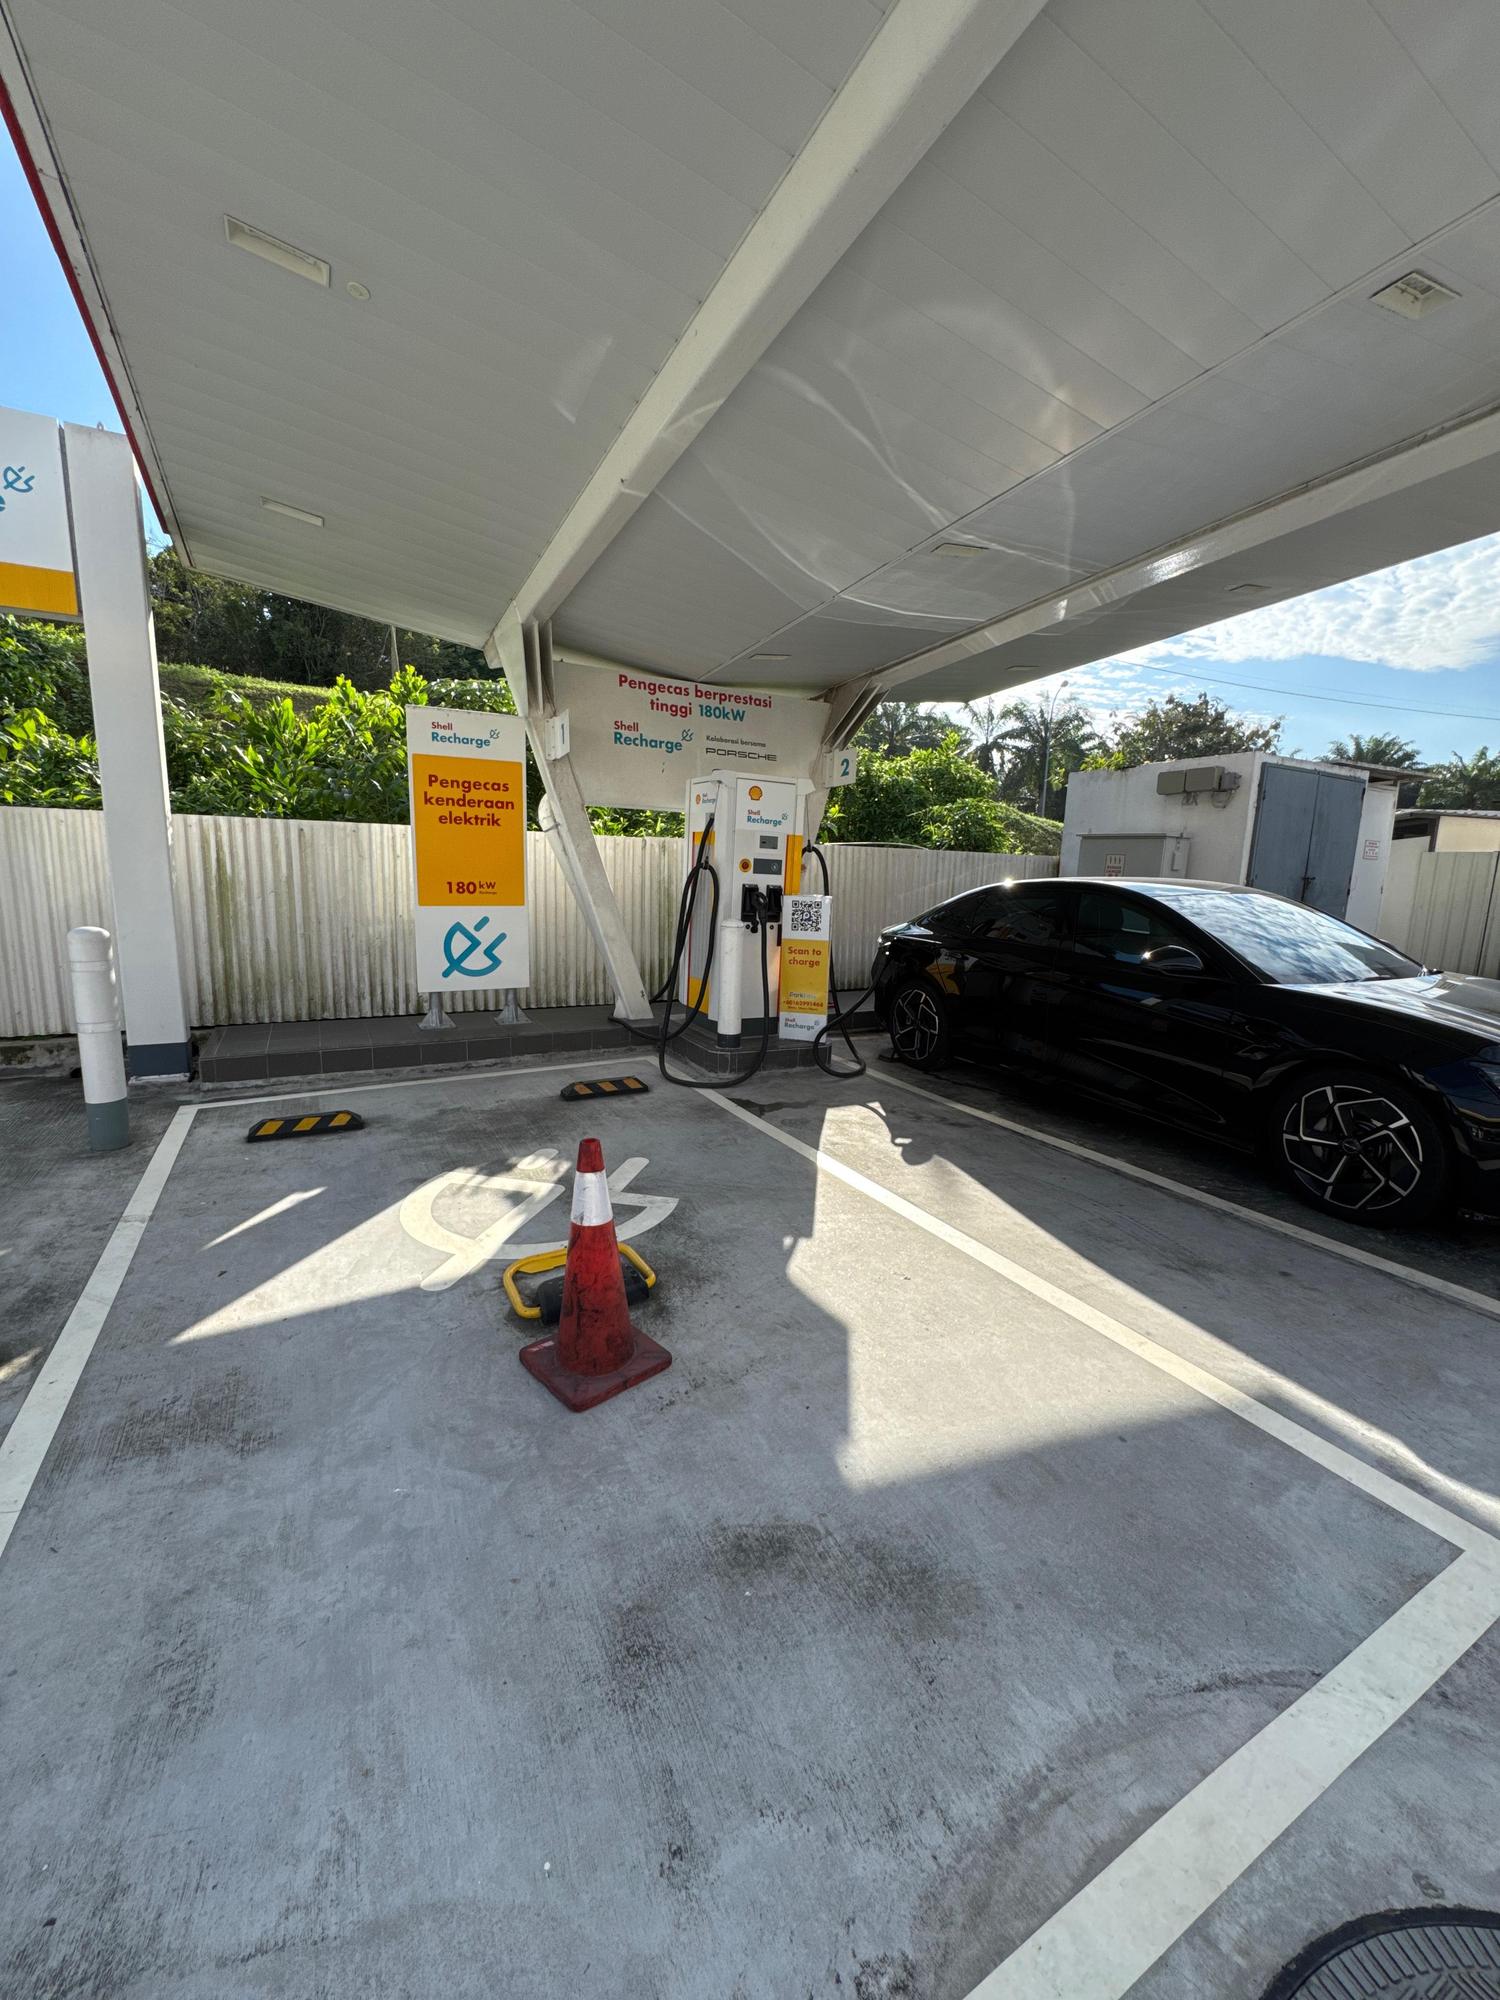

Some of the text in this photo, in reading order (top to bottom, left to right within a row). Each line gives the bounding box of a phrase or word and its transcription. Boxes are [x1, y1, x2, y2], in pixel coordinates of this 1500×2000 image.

[618, 674, 773, 709] Pengecas berprestasi
[650, 698, 746, 722] tinggi 180kW
[431, 721, 453, 731] Shell
[614, 720, 639, 732] Shell
[431, 731, 491, 748] Recharge
[613, 732, 683, 754] Recharge
[705, 747, 778, 762] PORSCHE
[840, 758, 850, 777] 2
[428, 774, 509, 793] Pengecas
[423, 791, 515, 810] kenderaan
[438, 810, 501, 827] elektrik
[746, 815, 783, 828] Recharge
[446, 880, 496, 895] 180 kW
[788, 946, 822, 956] Scan to
[788, 957, 821, 968] charge
